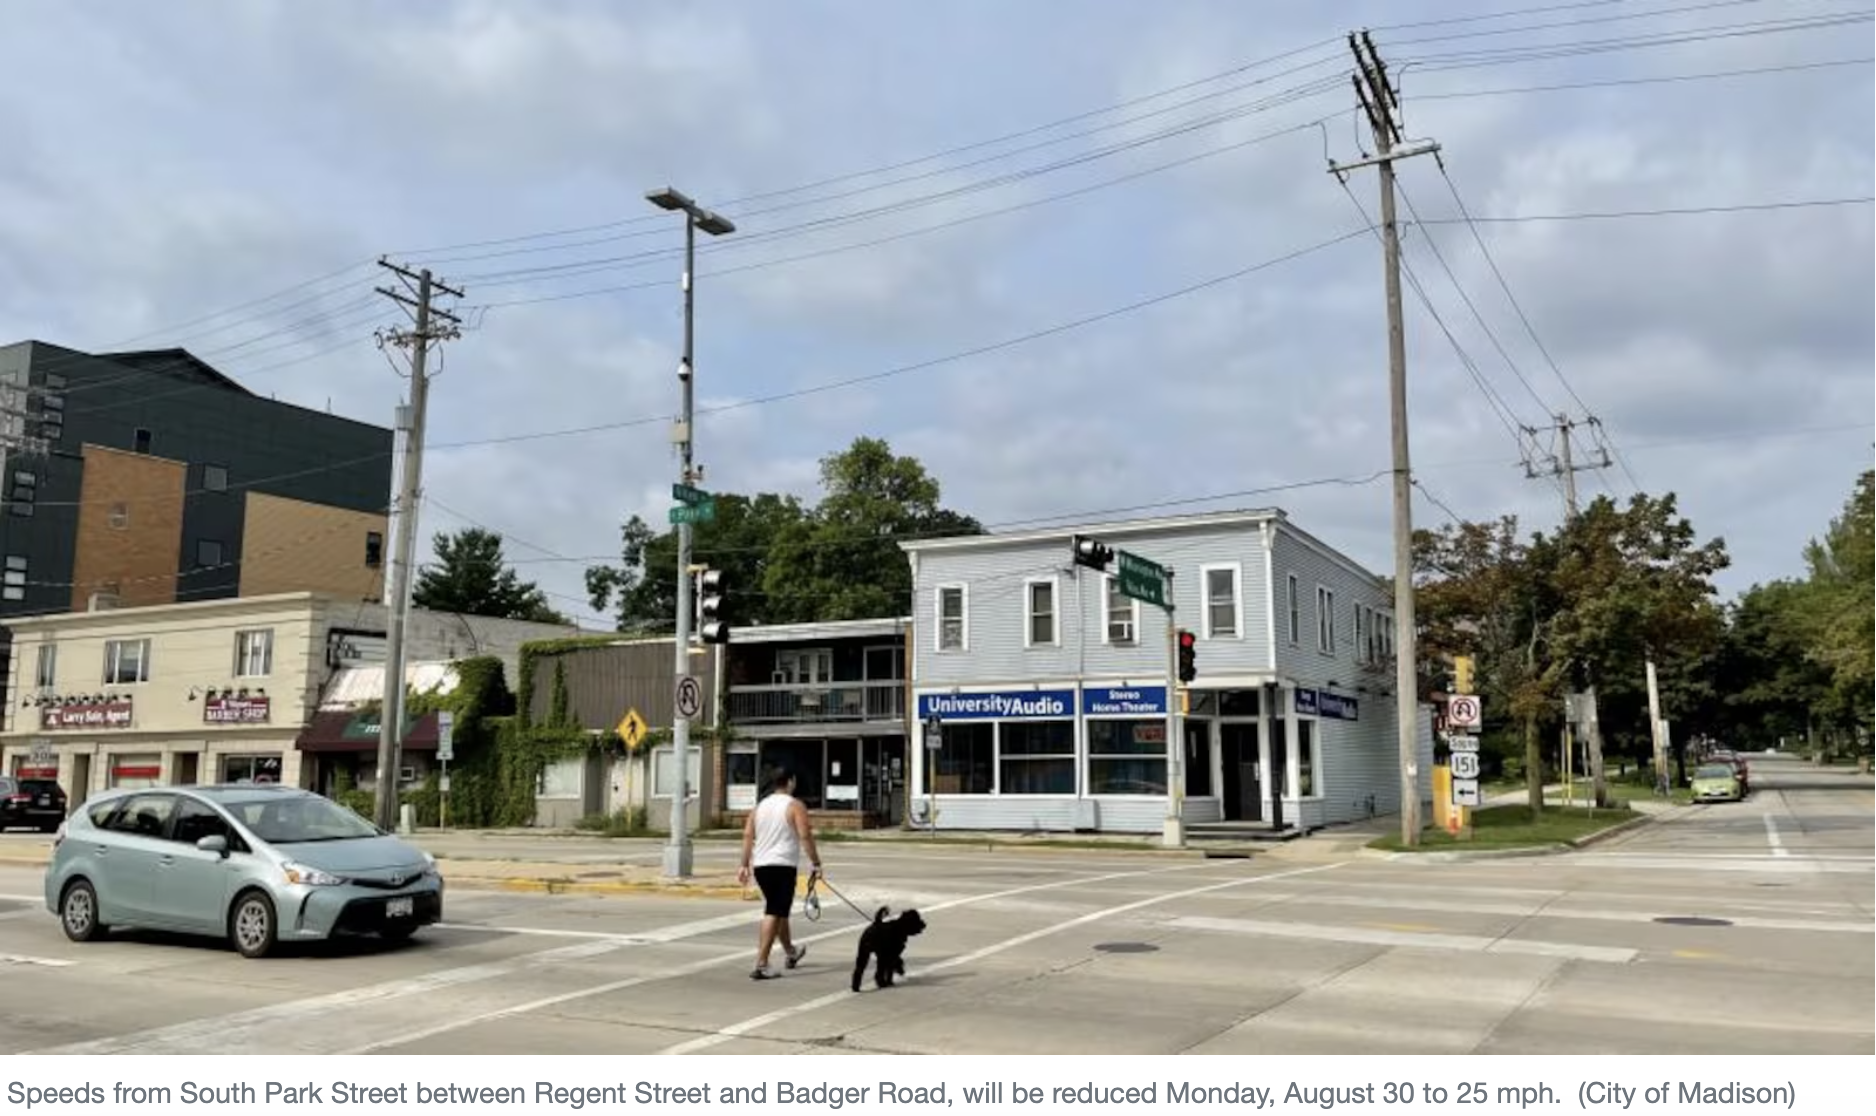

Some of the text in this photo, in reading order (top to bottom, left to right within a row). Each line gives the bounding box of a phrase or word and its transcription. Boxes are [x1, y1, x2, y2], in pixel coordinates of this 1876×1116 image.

[1109, 689, 1140, 700] Stereo
[1092, 702, 1159, 713] Home Theater
[206, 708, 267, 721] BARBER SHOP
[1455, 756, 1476, 773] 151
